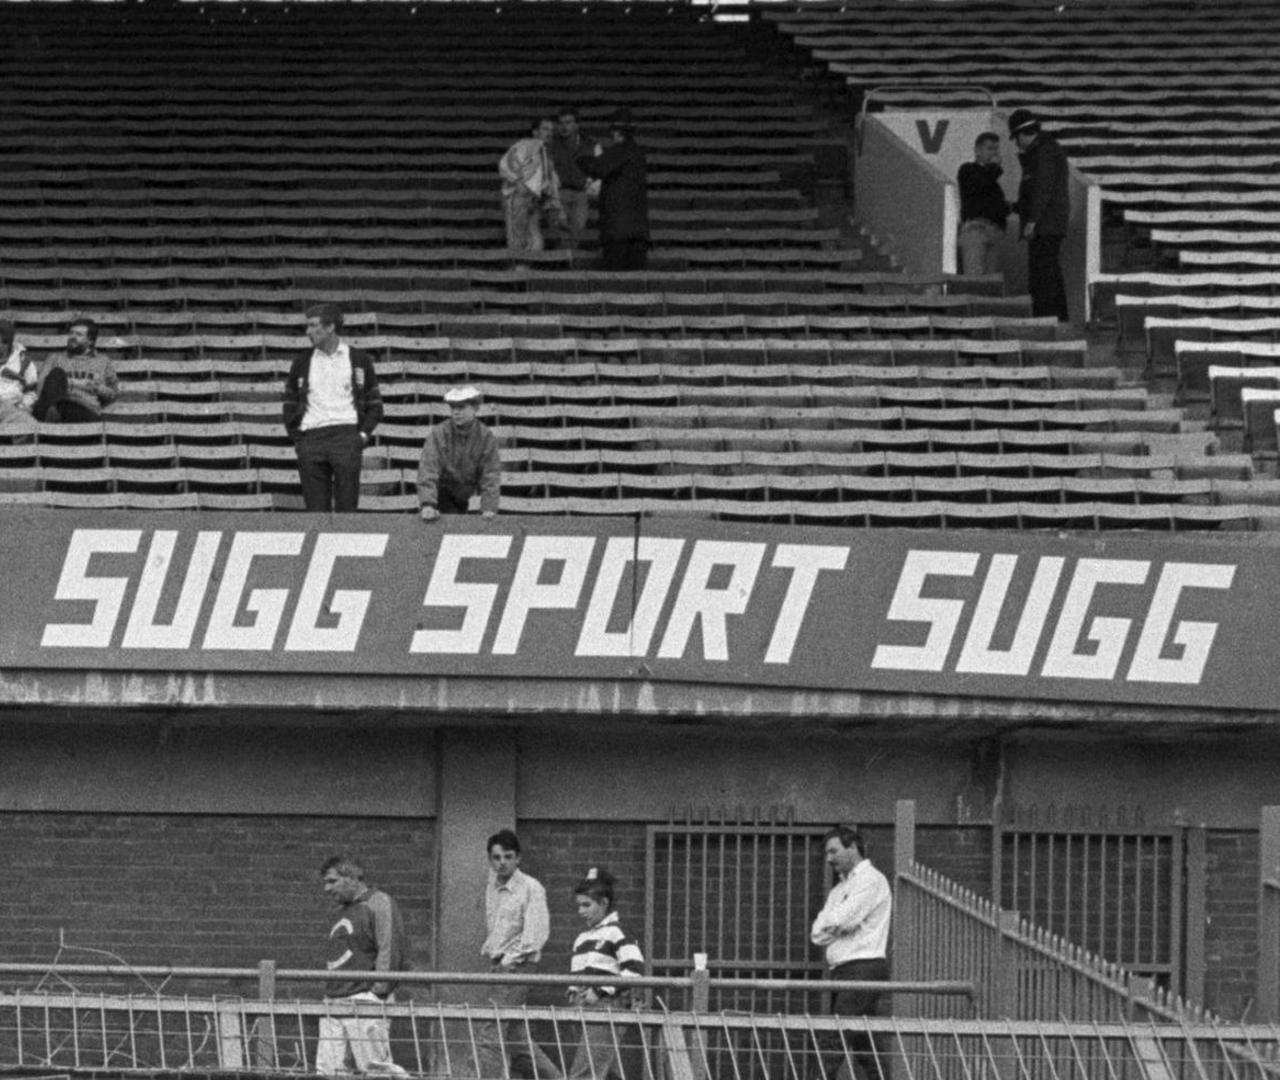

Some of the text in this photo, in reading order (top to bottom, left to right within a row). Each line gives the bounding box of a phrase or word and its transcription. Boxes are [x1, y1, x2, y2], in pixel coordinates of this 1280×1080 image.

[915, 119, 950, 155] V
[40, 528, 1236, 684] SUGG SPORT SUGG
